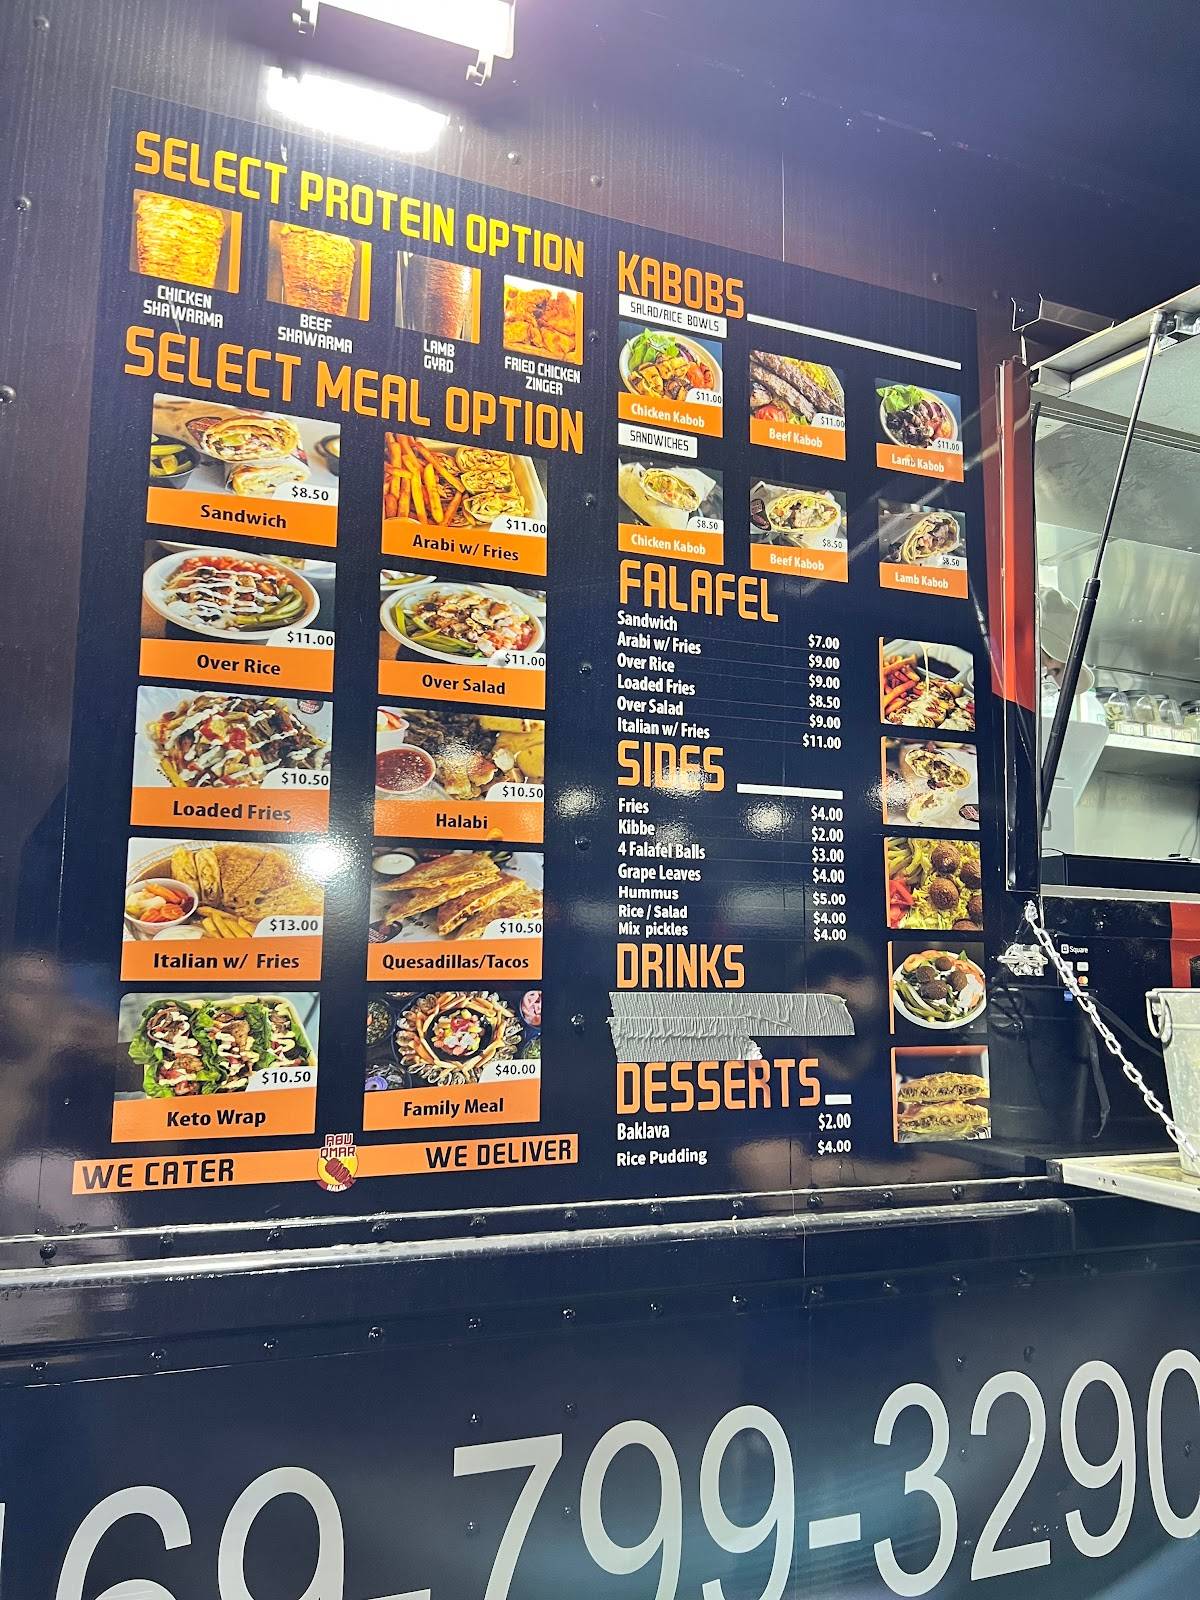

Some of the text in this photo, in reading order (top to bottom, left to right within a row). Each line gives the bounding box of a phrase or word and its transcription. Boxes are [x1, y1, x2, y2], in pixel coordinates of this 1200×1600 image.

[134, 130, 585, 279] SELECT PROTEIN OPTION
[618, 251, 744, 320] KABOBS
[157, 285, 212, 308] CHICKEN
[143, 300, 223, 329] SHAWARMA
[300, 313, 332, 332] BEEF
[630, 301, 720, 332] SALAD/RICE BOWLS
[277, 327, 353, 354] SHAWARMA
[423, 339, 455, 358] LAMB
[424, 355, 454, 374] GYRO
[505, 356, 581, 384] FRIED CHICKEN
[124, 325, 584, 455] SELECT MEAL OPTION
[525, 376, 563, 396] ZINGER
[696, 390, 722, 404] $11.00
[631, 403, 705, 428] Chicken Kabob
[821, 415, 845, 428] $11.00
[630, 430, 689, 452] SANDWICHES
[769, 428, 822, 449] Beef Kabob
[937, 440, 960, 451] $11.00
[891, 452, 944, 473] Lamb Kabob
[291, 486, 329, 501] $8.50
[201, 504, 287, 529] Sandwich
[506, 519, 546, 534] $11.00
[696, 518, 718, 531] $8.50
[413, 534, 519, 561] Arabi w/ Fries
[631, 533, 706, 556] Chicken Kabob
[822, 538, 843, 549] $8.50
[770, 553, 825, 572] Beef Kabob
[619, 559, 779, 623] FALAFEL
[895, 572, 948, 589] Lamb Kabob
[287, 631, 334, 646] $11.00
[617, 610, 840, 650] Sandwich $7.00
[505, 653, 545, 667] $11.00
[617, 631, 840, 670] Arabi w/ Fries $9.00
[197, 654, 281, 675] Over Rice
[617, 653, 841, 690] Over Rice $9.00
[422, 674, 505, 694] Over Salad
[617, 674, 841, 709] Loaded Fries $8.50
[617, 696, 841, 730] Over Salad $9.00
[617, 717, 842, 750] Italian w/ Fries $11.00
[617, 740, 725, 792] SIDES
[281, 773, 329, 786] $10.50
[502, 786, 543, 798] $10.50
[173, 800, 292, 822] Loaded Fries
[618, 798, 844, 822] Fries $4.00
[436, 813, 488, 829] Halabi
[618, 820, 844, 842] Kibbe $2.00
[618, 842, 844, 863] 4 Falafel Balls $3.00
[618, 863, 845, 884] Grape Leaves $4.00
[618, 886, 846, 906] Hummus $5.00
[270, 919, 318, 932] $13.00
[618, 905, 846, 925] Rice / Salad $4.00
[500, 922, 541, 934] $10.50
[618, 922, 847, 942] Mix pickles $4.00
[1070, 946, 1088, 954] Square
[153, 953, 299, 969] Italian w/ Fries
[382, 954, 529, 970] Quesadillas/Tacos
[616, 943, 745, 989] DRINKS
[262, 1071, 311, 1084] $10.50
[495, 1064, 536, 1075] $40.00
[616, 1058, 821, 1115] DESSERTS
[167, 1109, 266, 1127] Keto Wrap
[403, 1098, 503, 1118] Family Meal
[617, 1113, 851, 1140] Baklava $2.00
[326, 1133, 353, 1146] ABU
[320, 1145, 356, 1158] OMAR
[426, 1139, 571, 1168] WE DELIVER
[616, 1140, 851, 1166] Rice Pudding $4.00
[82, 1158, 234, 1190] WE CATER
